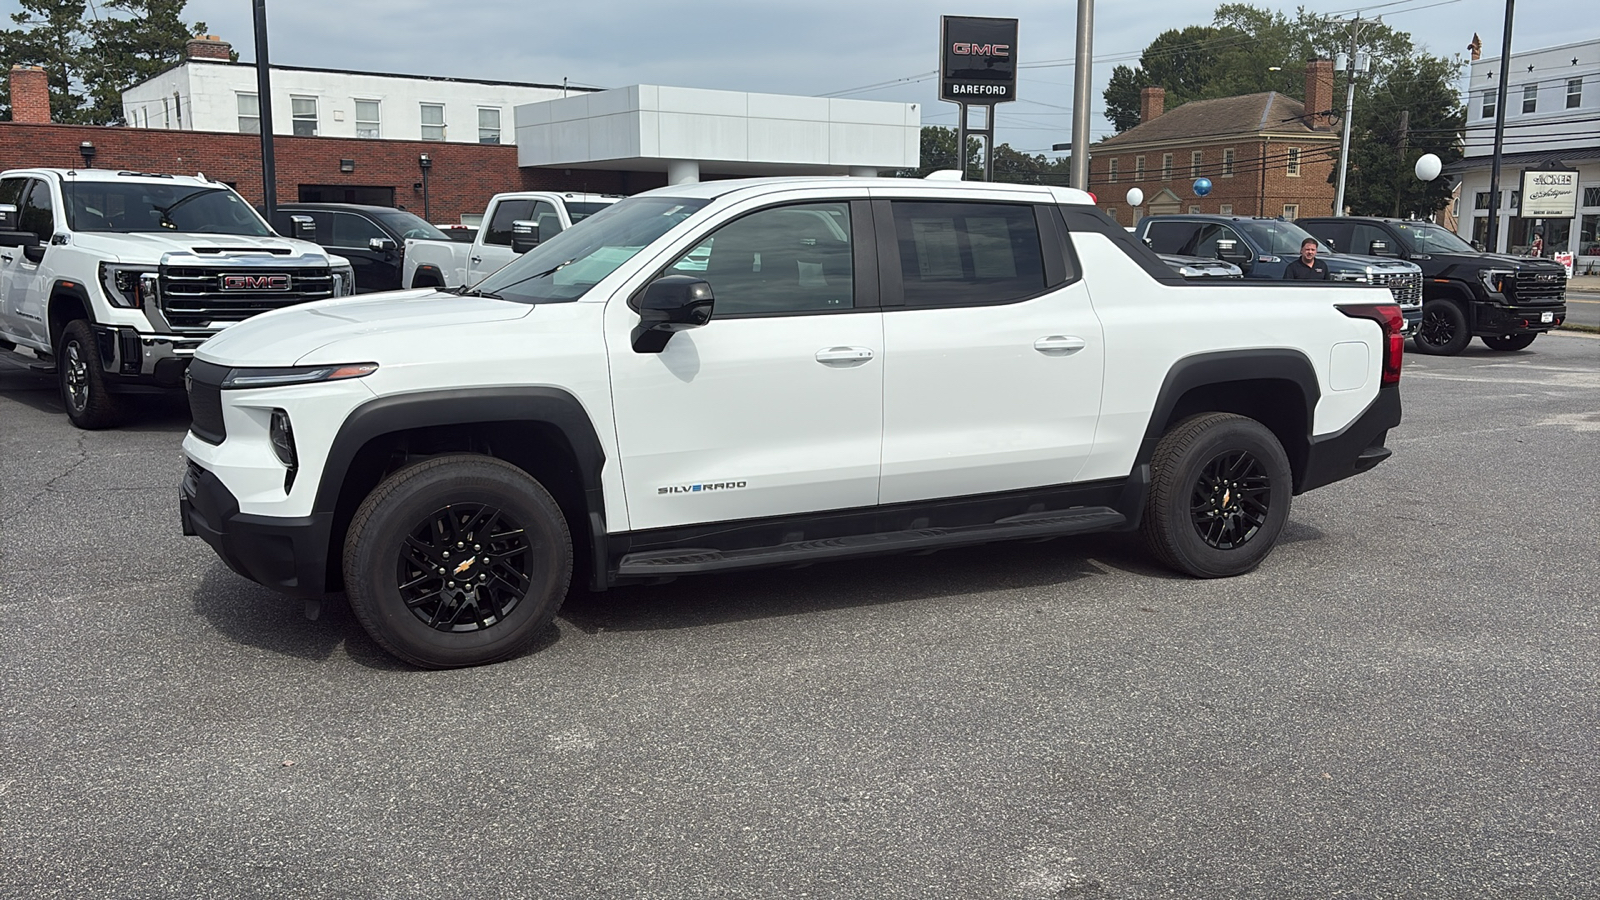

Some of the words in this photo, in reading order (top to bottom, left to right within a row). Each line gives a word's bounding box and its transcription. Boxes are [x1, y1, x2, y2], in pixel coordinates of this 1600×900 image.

[953, 43, 1009, 56] GMC
[953, 84, 1006, 95] BAREFORD
[1533, 174, 1572, 186] ACME
[225, 276, 287, 289] GMC
[658, 481, 747, 494] SILVERADO
